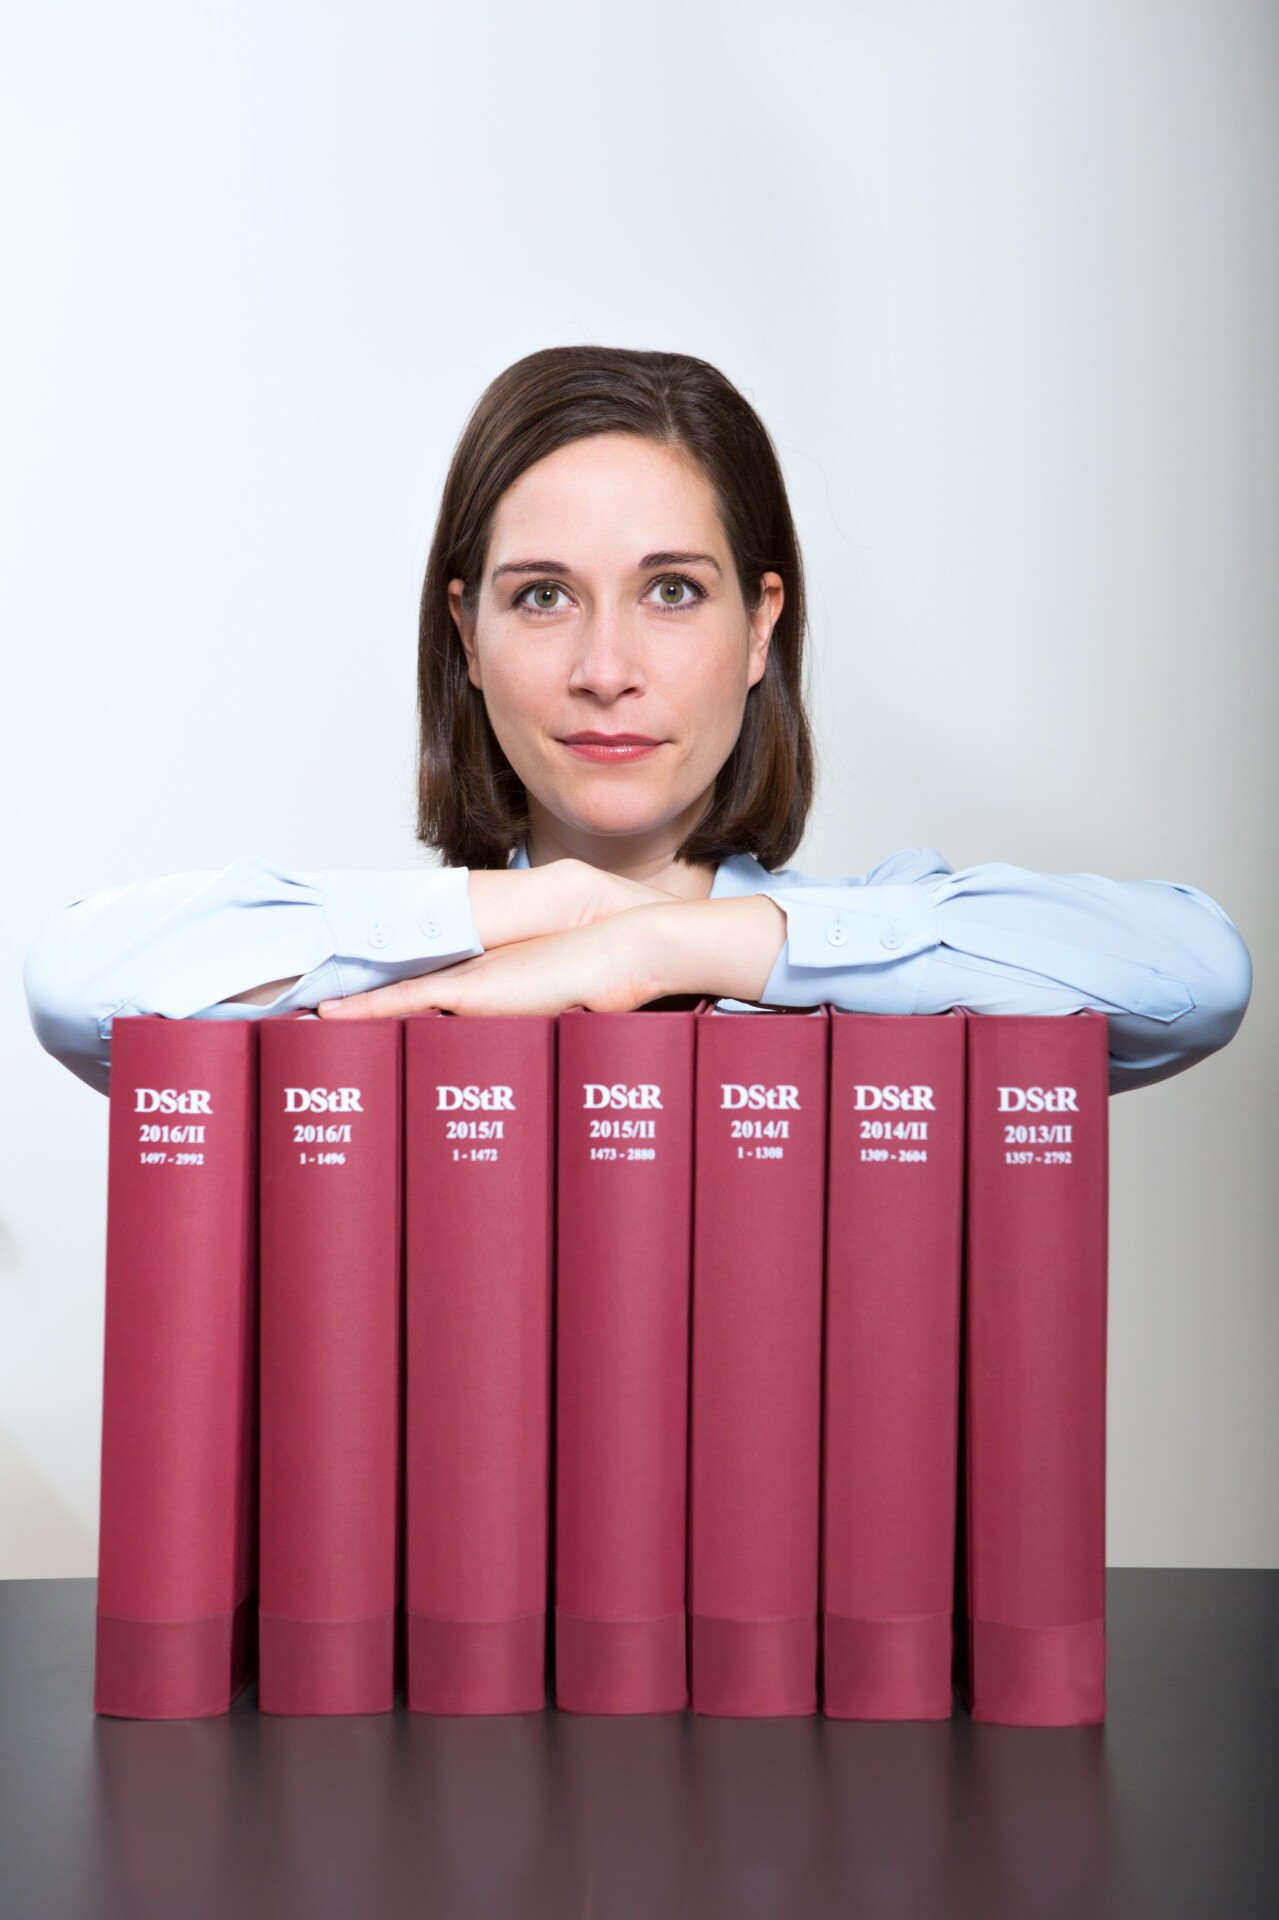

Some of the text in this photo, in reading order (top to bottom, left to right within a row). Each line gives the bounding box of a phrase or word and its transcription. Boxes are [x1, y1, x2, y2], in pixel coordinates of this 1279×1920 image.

[134, 1088, 214, 1115] DStR
[284, 1086, 365, 1113] DStR
[436, 1085, 517, 1111] DStR
[583, 1083, 664, 1110] DStR
[720, 1084, 801, 1110] DStR
[853, 1085, 936, 1111] DStR
[997, 1086, 1079, 1113] DStR
[139, 1124, 207, 1144] 2016/II
[293, 1124, 353, 1143] 2016/I
[446, 1120, 505, 1140] 2015/I
[590, 1119, 656, 1139] 2015/II
[731, 1120, 790, 1139] 2014/I
[860, 1120, 928, 1140] 2014/II
[1004, 1125, 1072, 1144] 2013/II
[141, 1152, 166, 1164] 1497
[175, 1153, 204, 1165] 2992
[300, 1153, 306, 1164] 1
[318, 1152, 346, 1165] 1496
[453, 1149, 459, 1161] 1
[471, 1148, 498, 1161] 1472
[591, 1148, 617, 1160] 1473
[738, 1146, 743, 1158] 1
[1006, 1152, 1034, 1164] 1357
[1044, 1152, 1072, 1164] 2792
